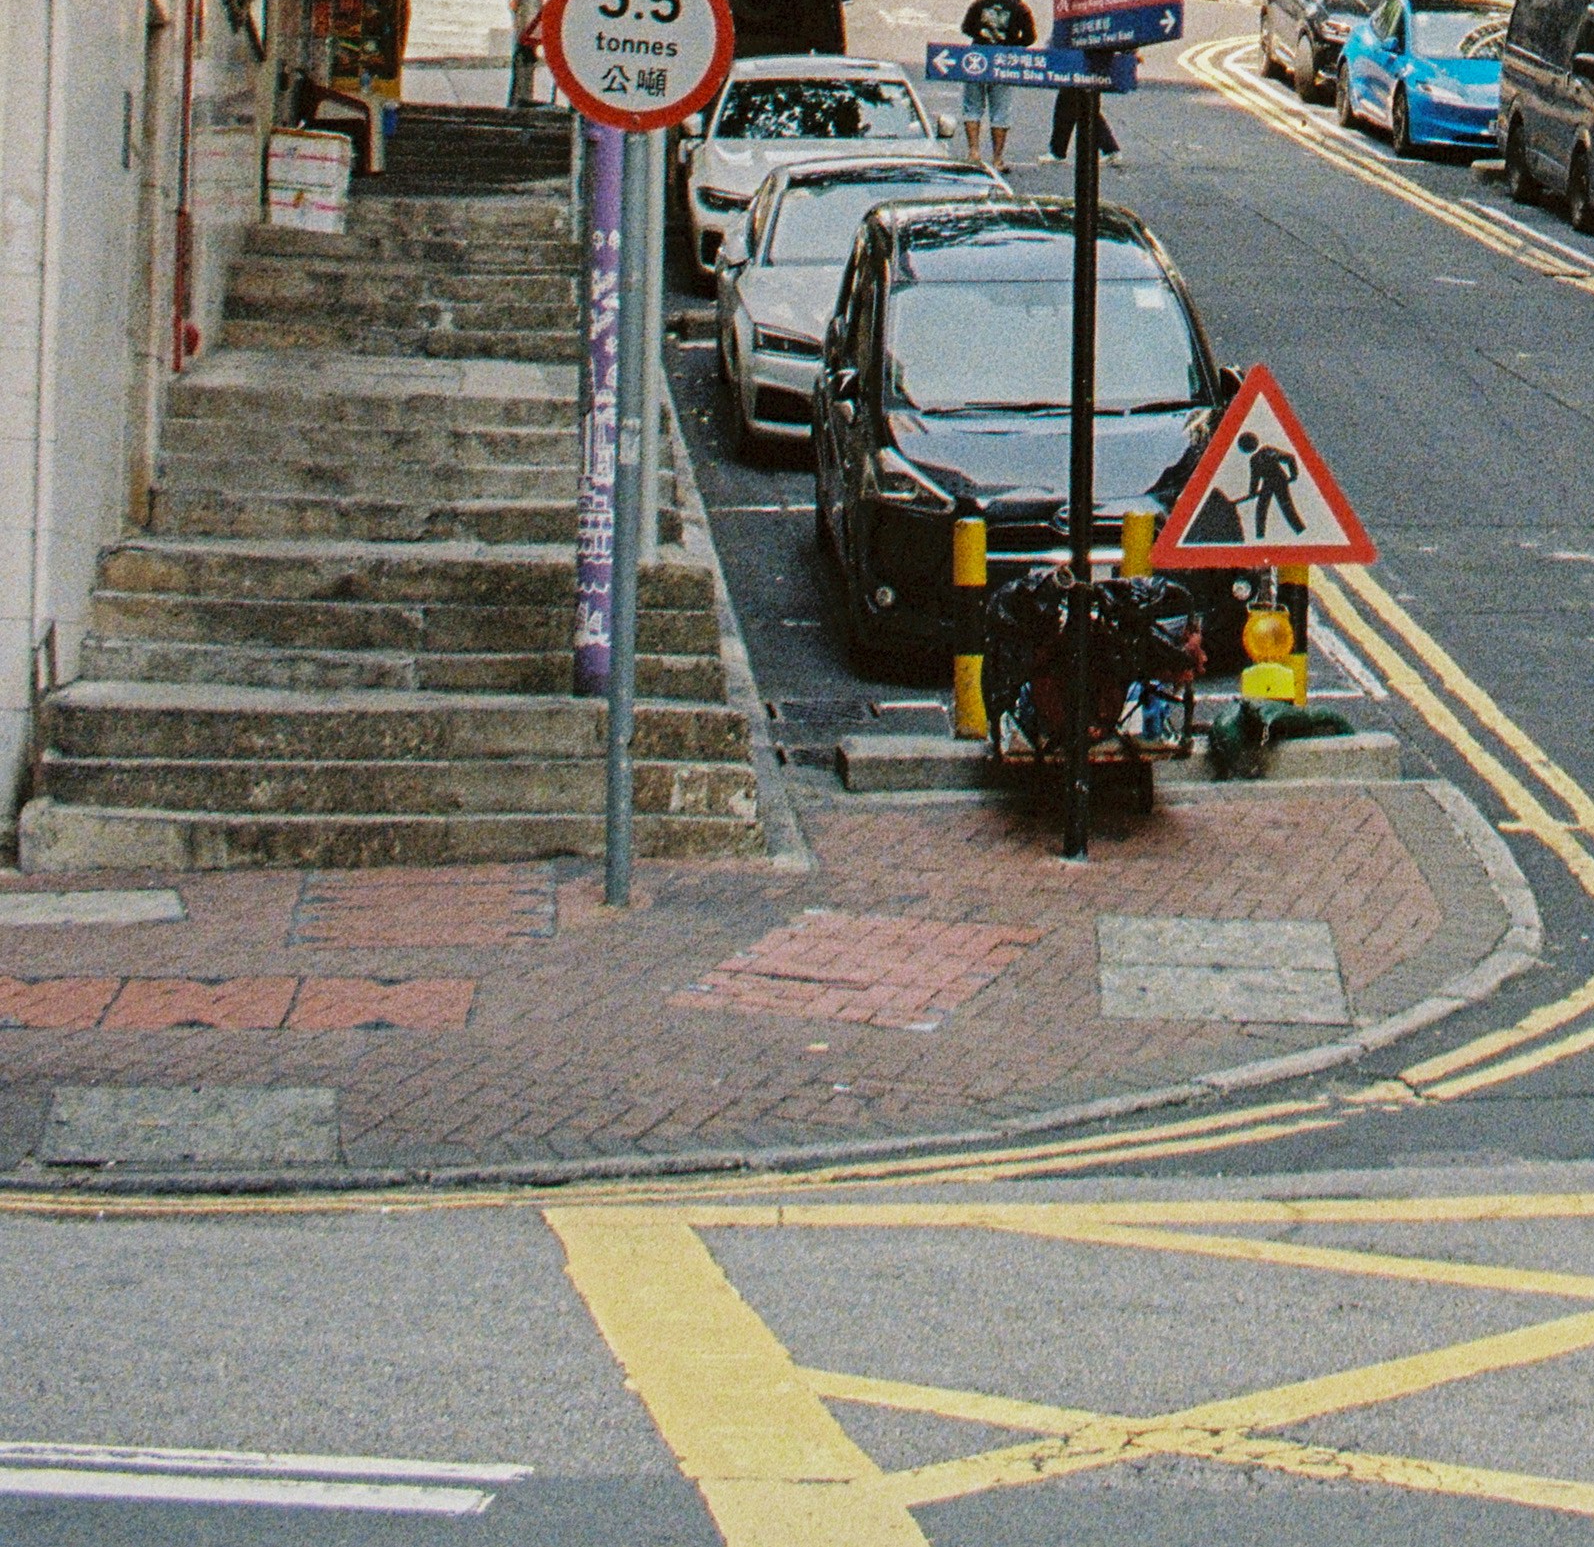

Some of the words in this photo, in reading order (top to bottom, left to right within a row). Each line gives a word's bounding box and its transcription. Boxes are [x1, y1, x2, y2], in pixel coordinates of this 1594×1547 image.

[595, 31, 678, 57] tonnes
[993, 53, 1047, 69] 尖沙咀站
[601, 64, 669, 97] 公噸
[993, 67, 1020, 80] Tsim
[1022, 69, 1044, 81] Sha
[1047, 70, 1070, 82] Tsui
[1072, 72, 1112, 85] Station
